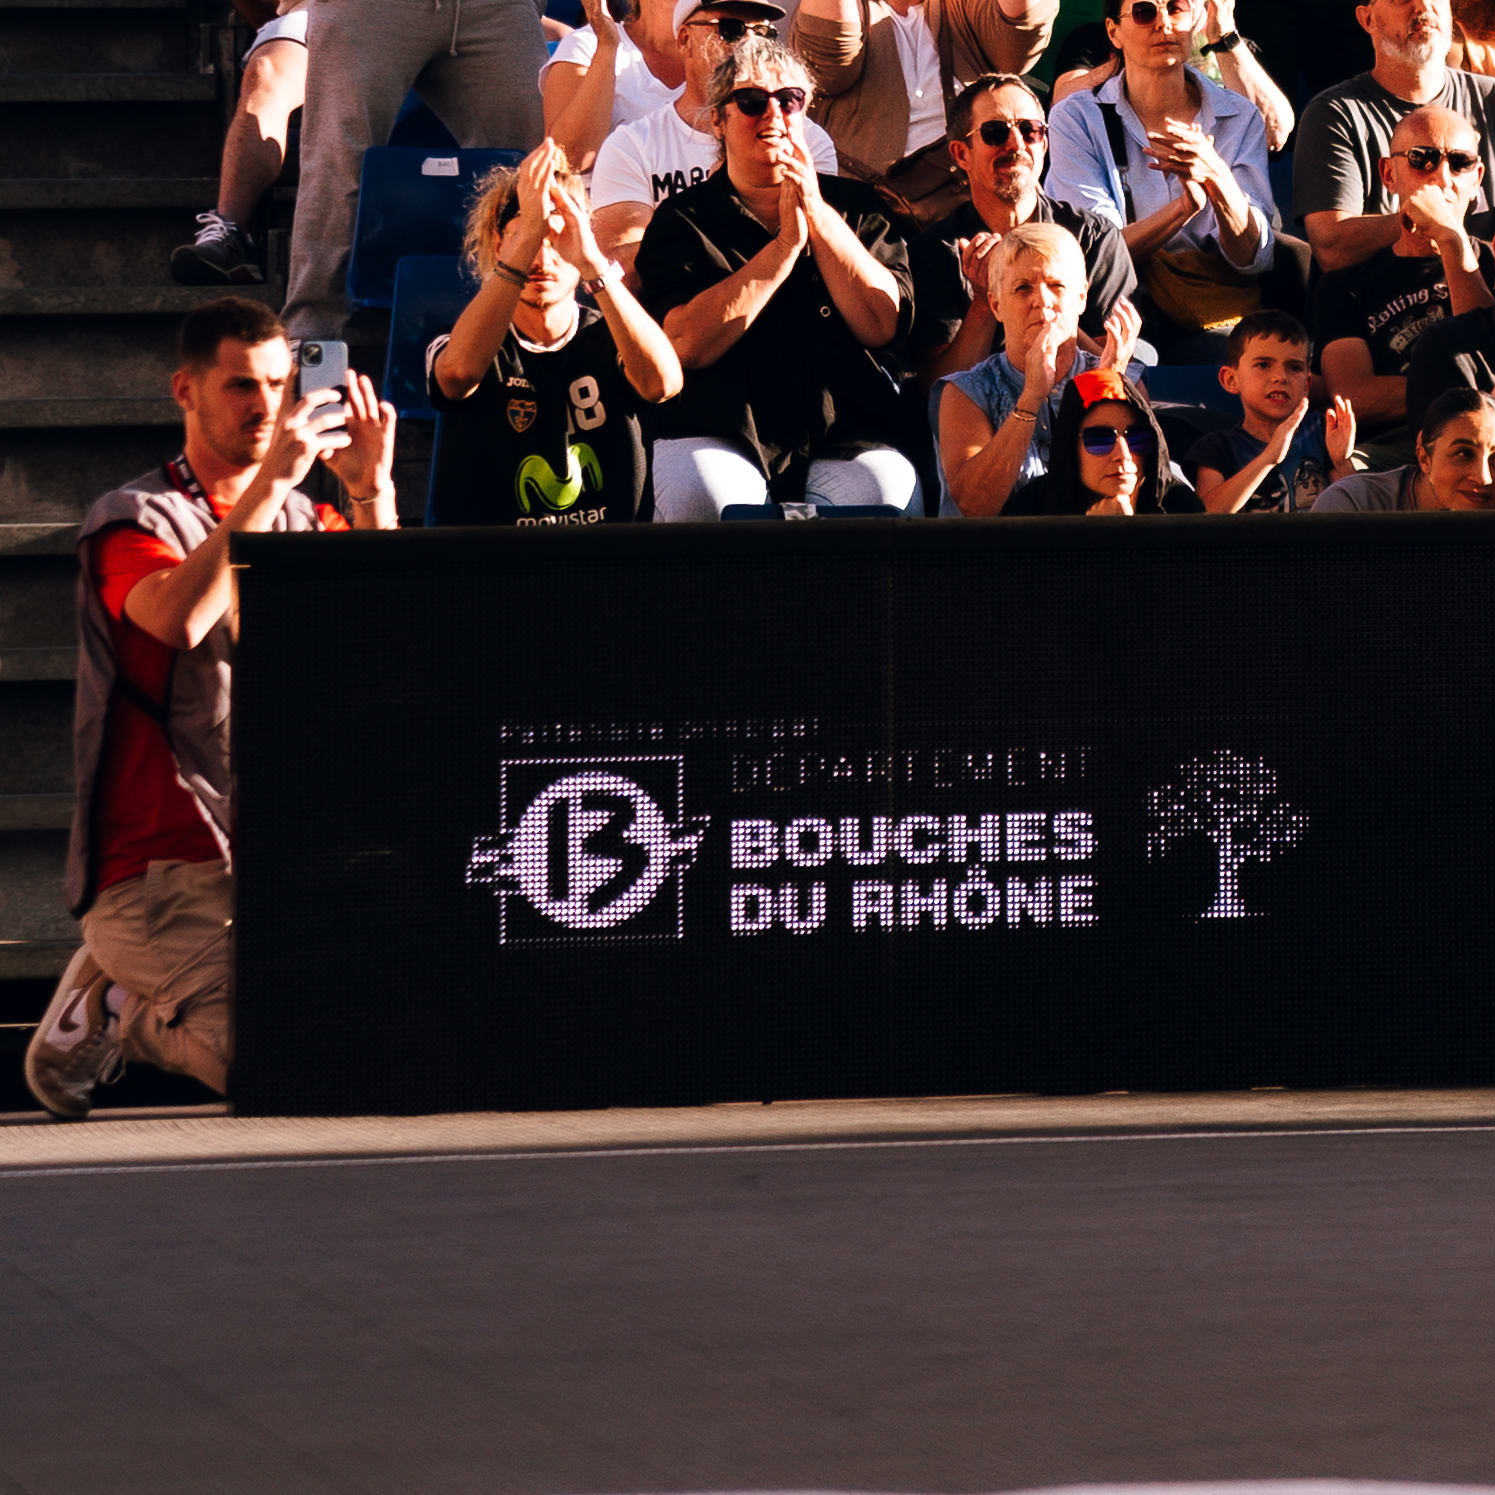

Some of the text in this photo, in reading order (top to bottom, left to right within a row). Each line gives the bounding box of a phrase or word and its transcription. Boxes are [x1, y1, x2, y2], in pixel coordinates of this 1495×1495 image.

[651, 166, 710, 202] MAR
[566, 375, 607, 435] 8
[730, 811, 1098, 868] BOUCHES
[730, 863, 1099, 936] DU RHÔNE
